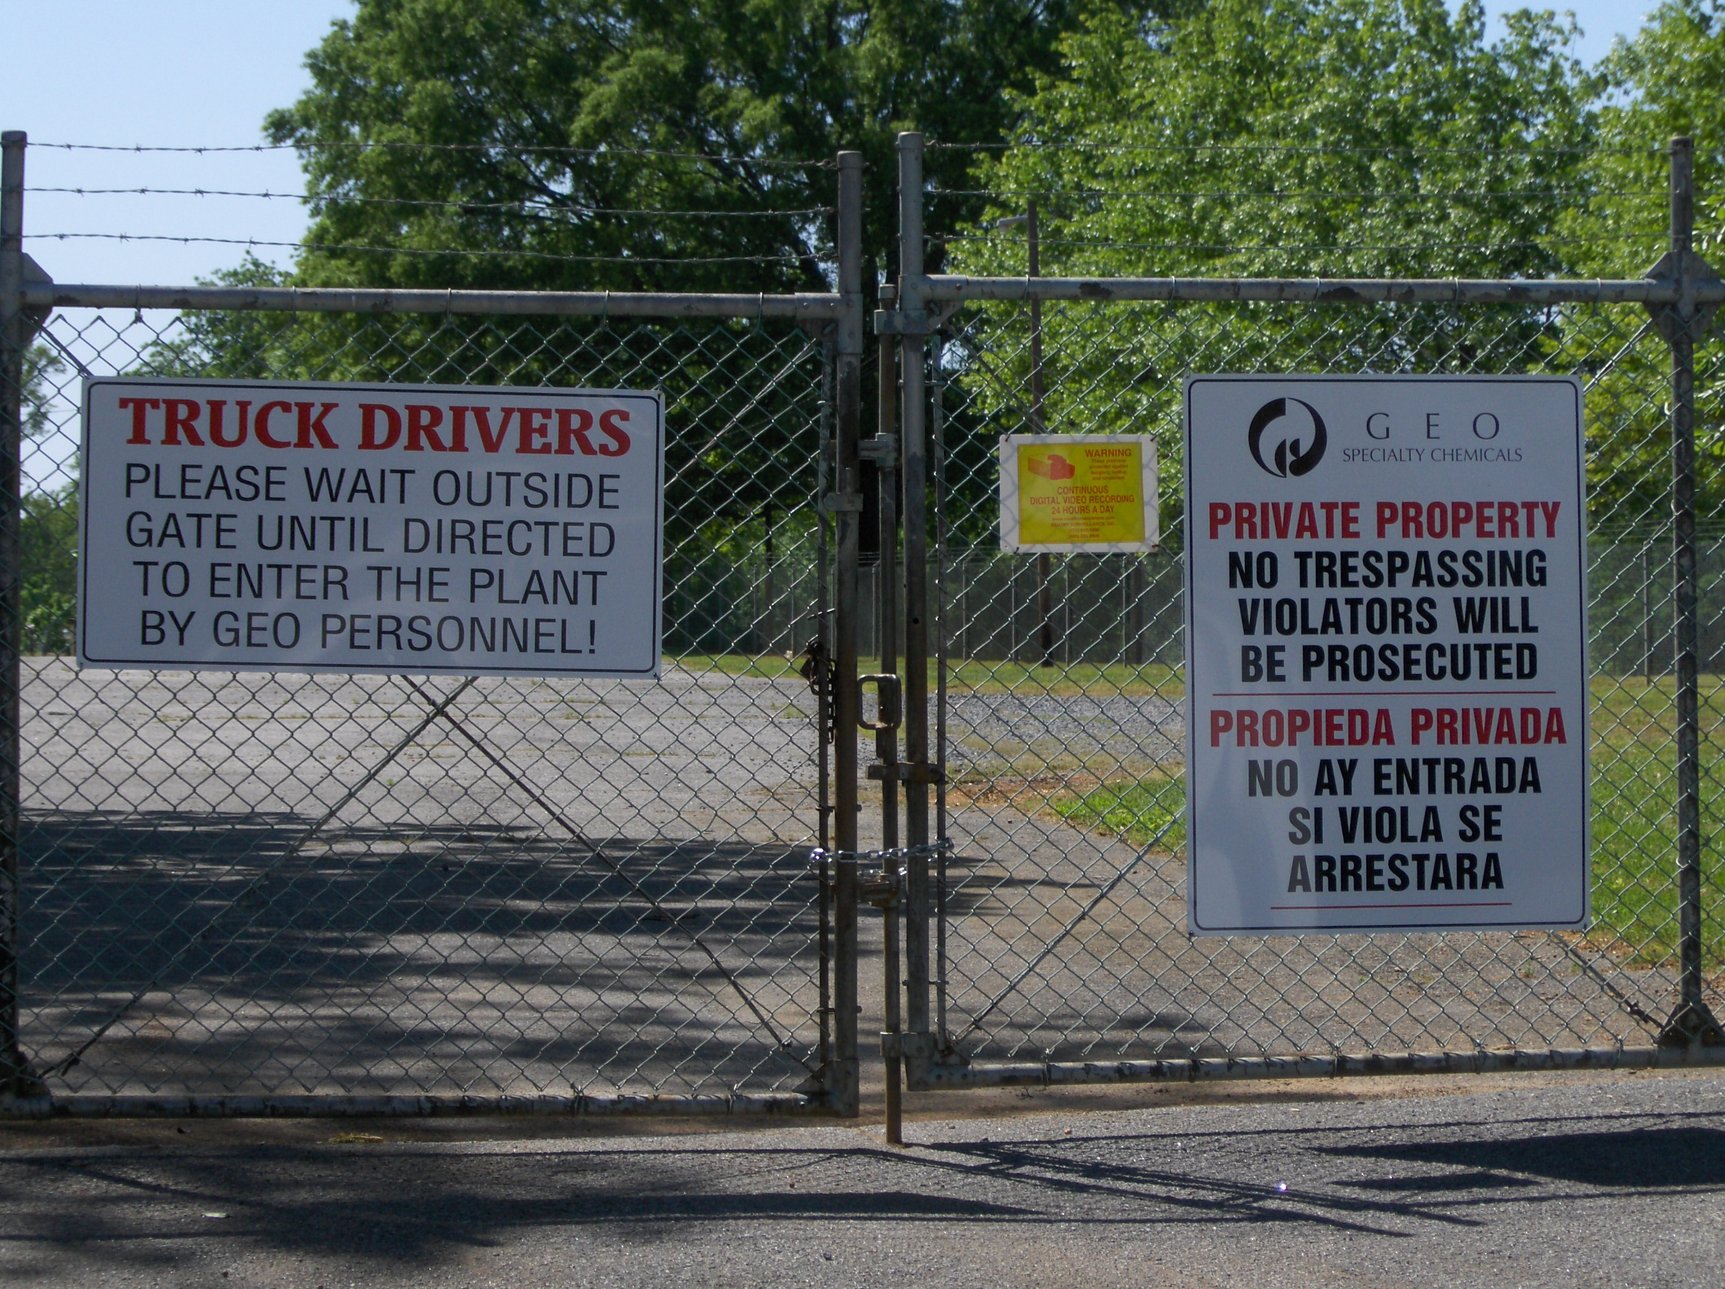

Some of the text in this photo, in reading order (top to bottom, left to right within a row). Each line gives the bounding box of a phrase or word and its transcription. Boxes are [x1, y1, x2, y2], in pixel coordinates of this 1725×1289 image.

[119, 397, 631, 457] TRUCK DRIVERS
[1085, 449, 1131, 458] WARNING
[1342, 448, 1523, 462] SPECIALTY CHEMICALS
[126, 463, 621, 509] PLEASE WAIT OUTSIDE
[1030, 495, 1135, 505] DIGITAL VIDEO RECORDING
[1057, 485, 1109, 495] CONTINUOUS
[1052, 507, 1060, 515] 24
[1063, 506, 1090, 514] HOURS
[1100, 505, 1115, 513] DAY
[1209, 501, 1561, 540] PRIVATE PROPERTY
[126, 511, 616, 557] GATE UNTIL DIRECTED
[133, 560, 608, 605] TO ENTER THE PLANT
[1229, 549, 1547, 588] NO TRESPASSING
[141, 610, 596, 654] BY GEO PERSONNEL!
[1238, 596, 1539, 635] VIOLATORS WILL
[1241, 643, 1537, 682] BE PROSECUTED
[1210, 707, 1567, 747] PROPIEDA PRIVADA
[1248, 756, 1541, 797] NO AY ENTRADA
[1288, 804, 1503, 845] SI VIOLA SE
[1287, 852, 1504, 893] ARRESTARA
